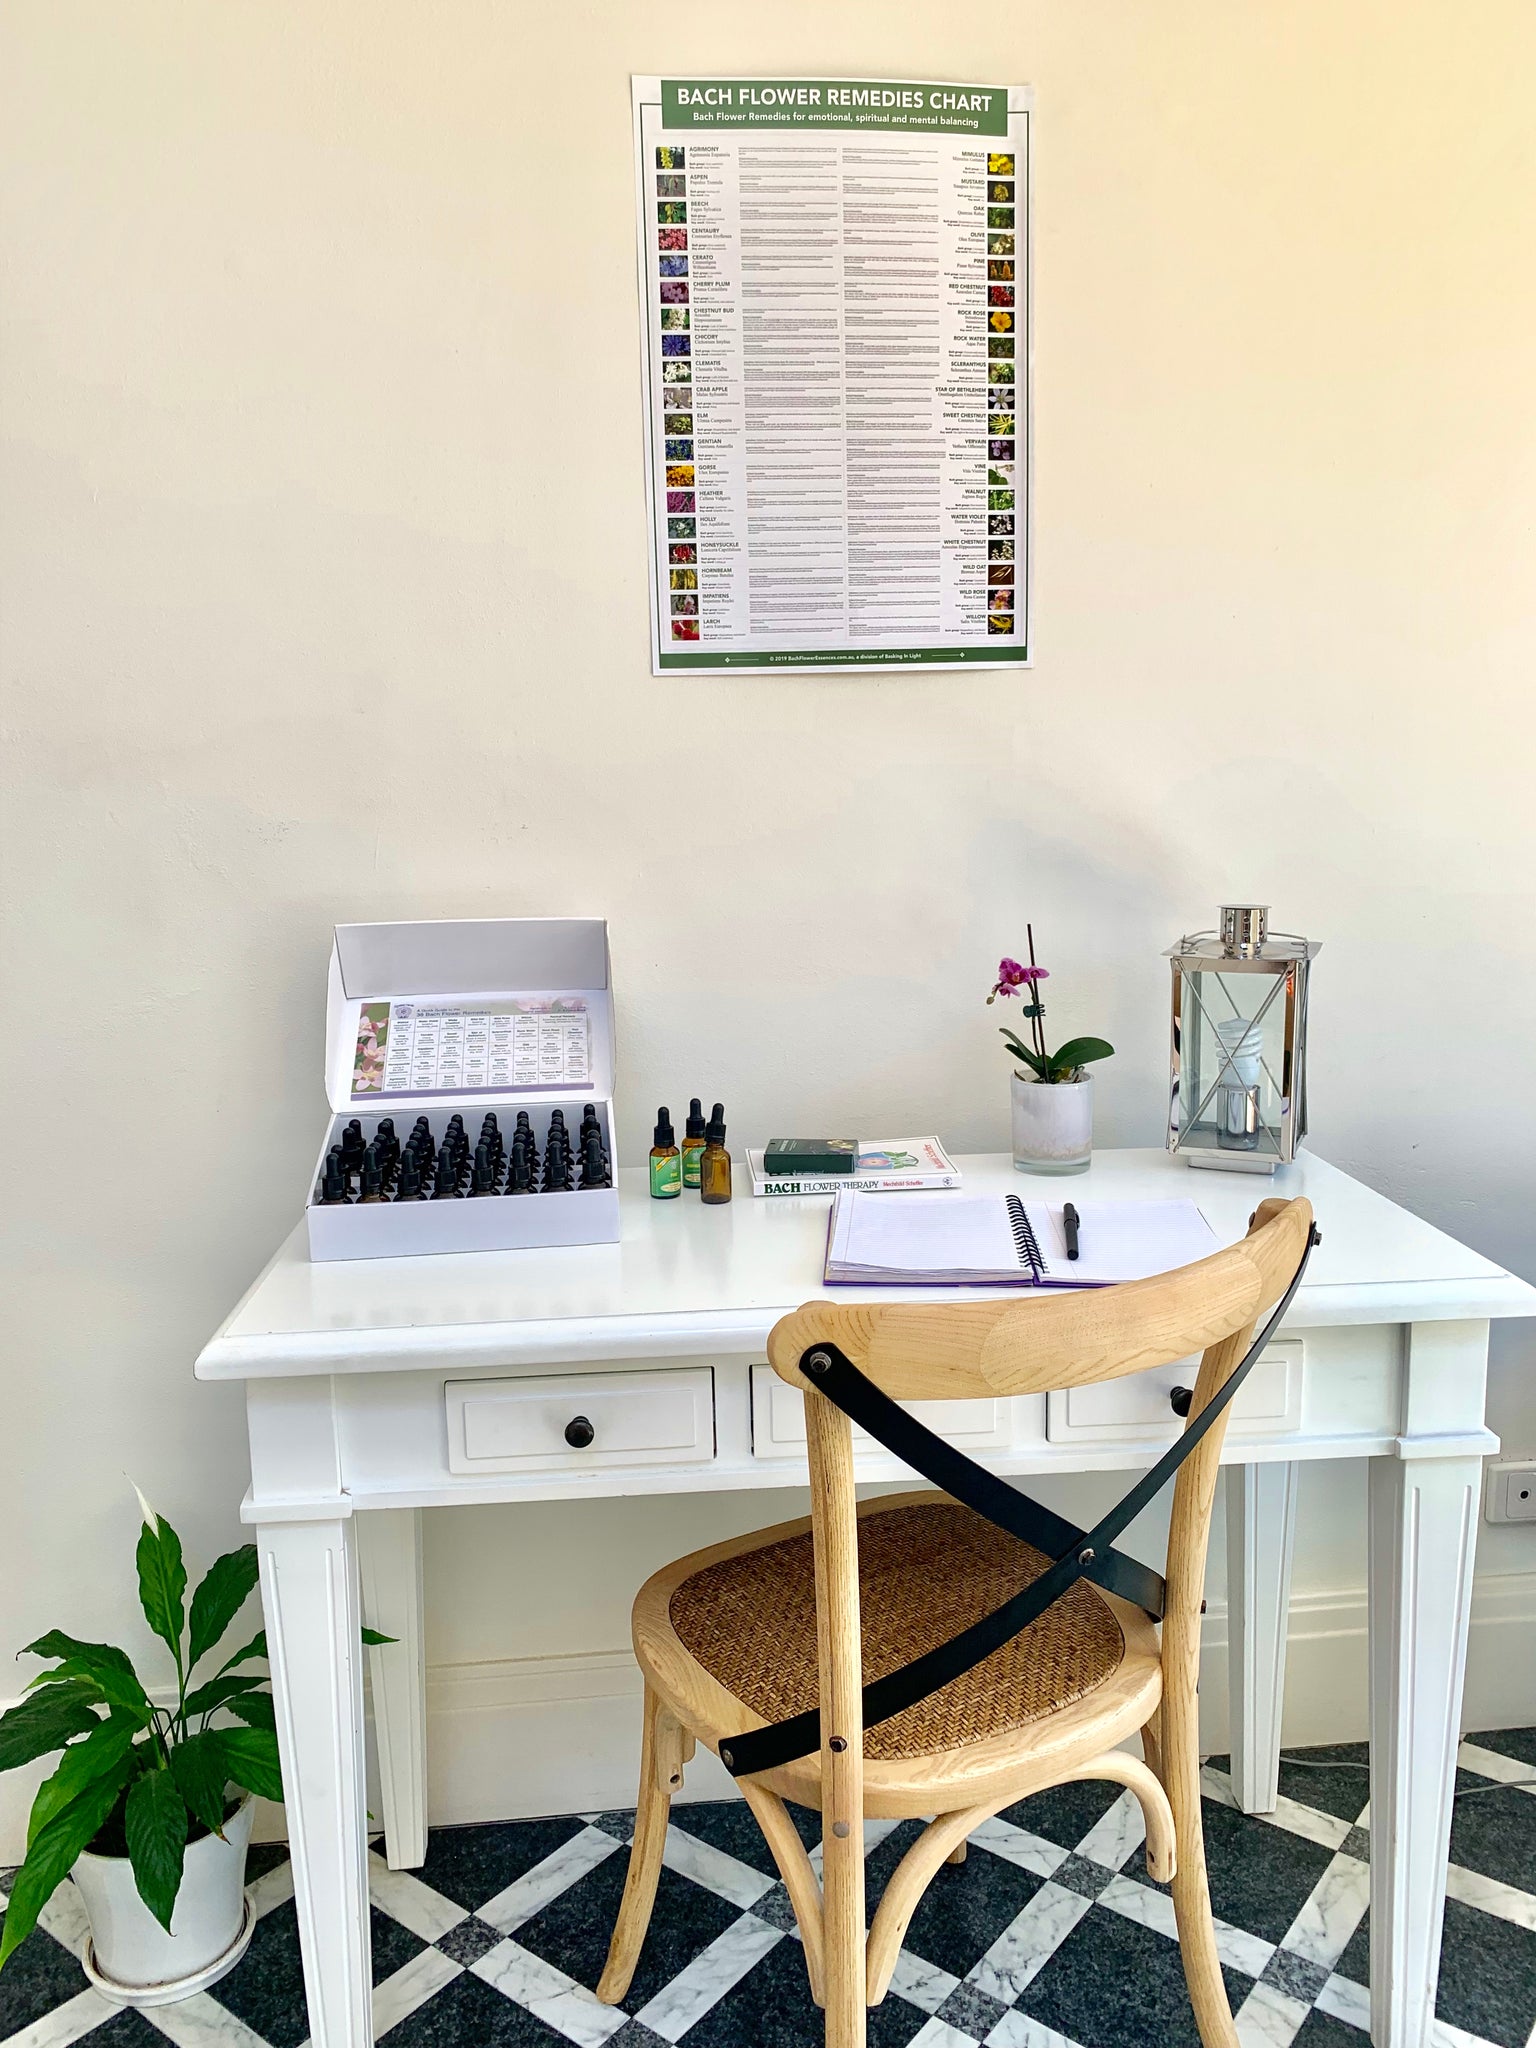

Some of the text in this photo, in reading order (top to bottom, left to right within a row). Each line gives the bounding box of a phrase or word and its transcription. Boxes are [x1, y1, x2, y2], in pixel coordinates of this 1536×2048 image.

[678, 88, 992, 112] BACH FLOWER REMEDIES CHART
[693, 112, 979, 128] Bach Flower Remedies for emotional, spiritual and mental balancing
[764, 1182, 801, 1194] BACH
[803, 1182, 840, 1191] FLOWER
[842, 1180, 879, 1190] THERAPY
